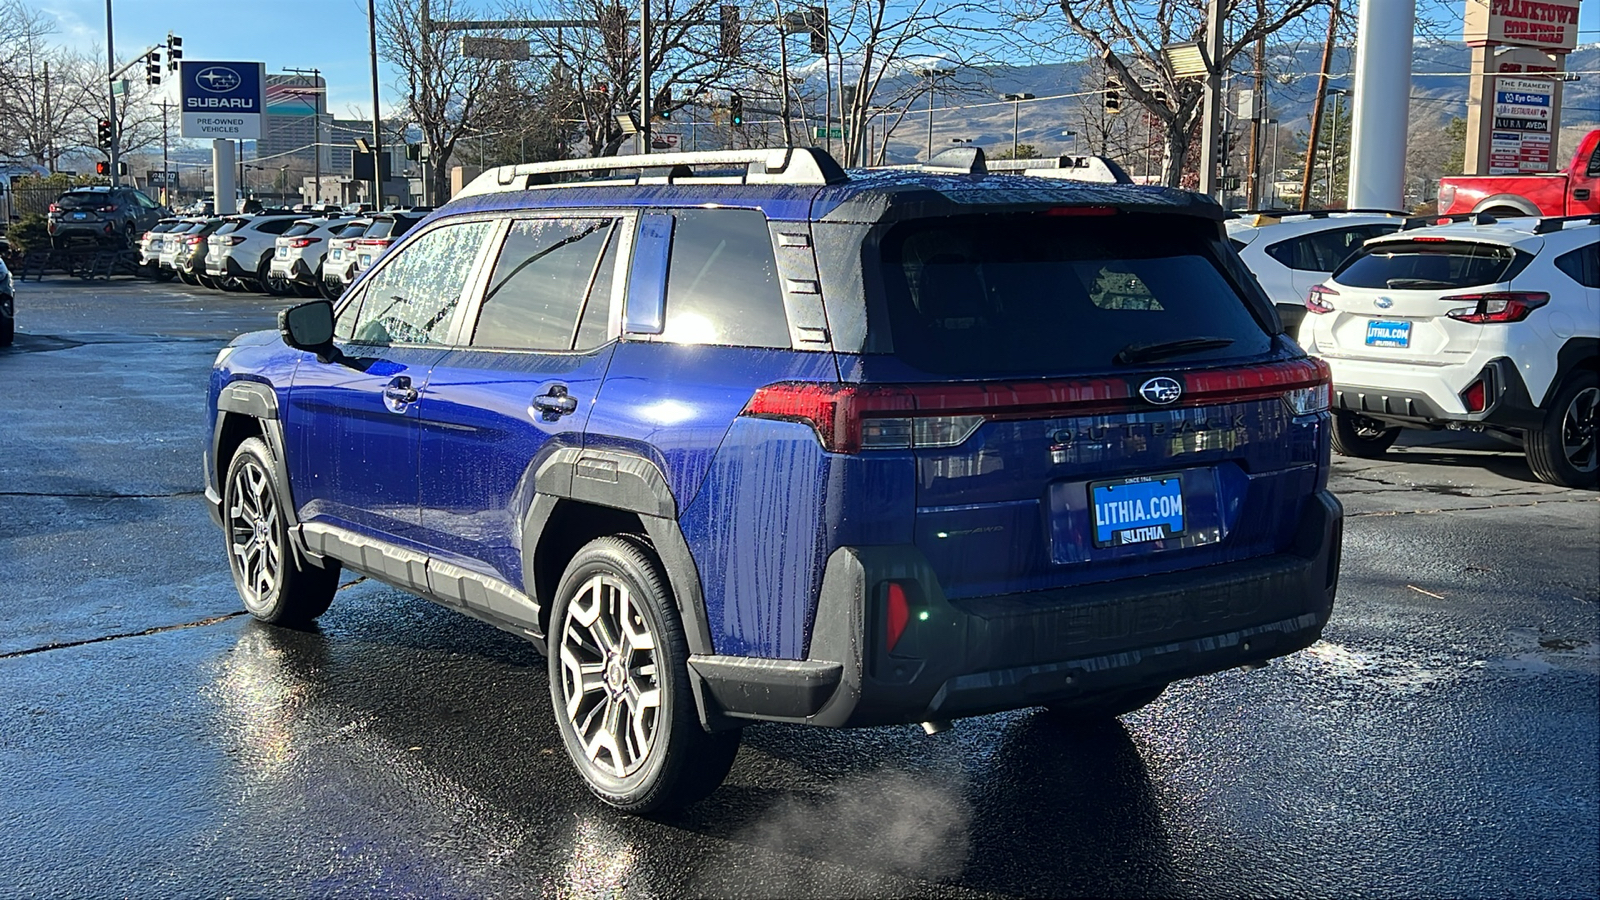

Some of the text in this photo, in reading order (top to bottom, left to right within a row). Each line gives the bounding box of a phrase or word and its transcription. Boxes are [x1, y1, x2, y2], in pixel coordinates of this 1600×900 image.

[1492, 0, 1579, 24] FRANKTOWN
[187, 97, 253, 108] SUBARU
[1515, 95, 1543, 103] Eye Clinic
[1497, 119, 1547, 129] AURA AVEDA
[1368, 327, 1408, 340] LITHIA.COM
[1053, 414, 1246, 444] OUTBACK
[1125, 475, 1152, 484] SINCE 1946
[1095, 494, 1183, 526] LITHIA.COM
[1131, 526, 1165, 542] LITHIA
